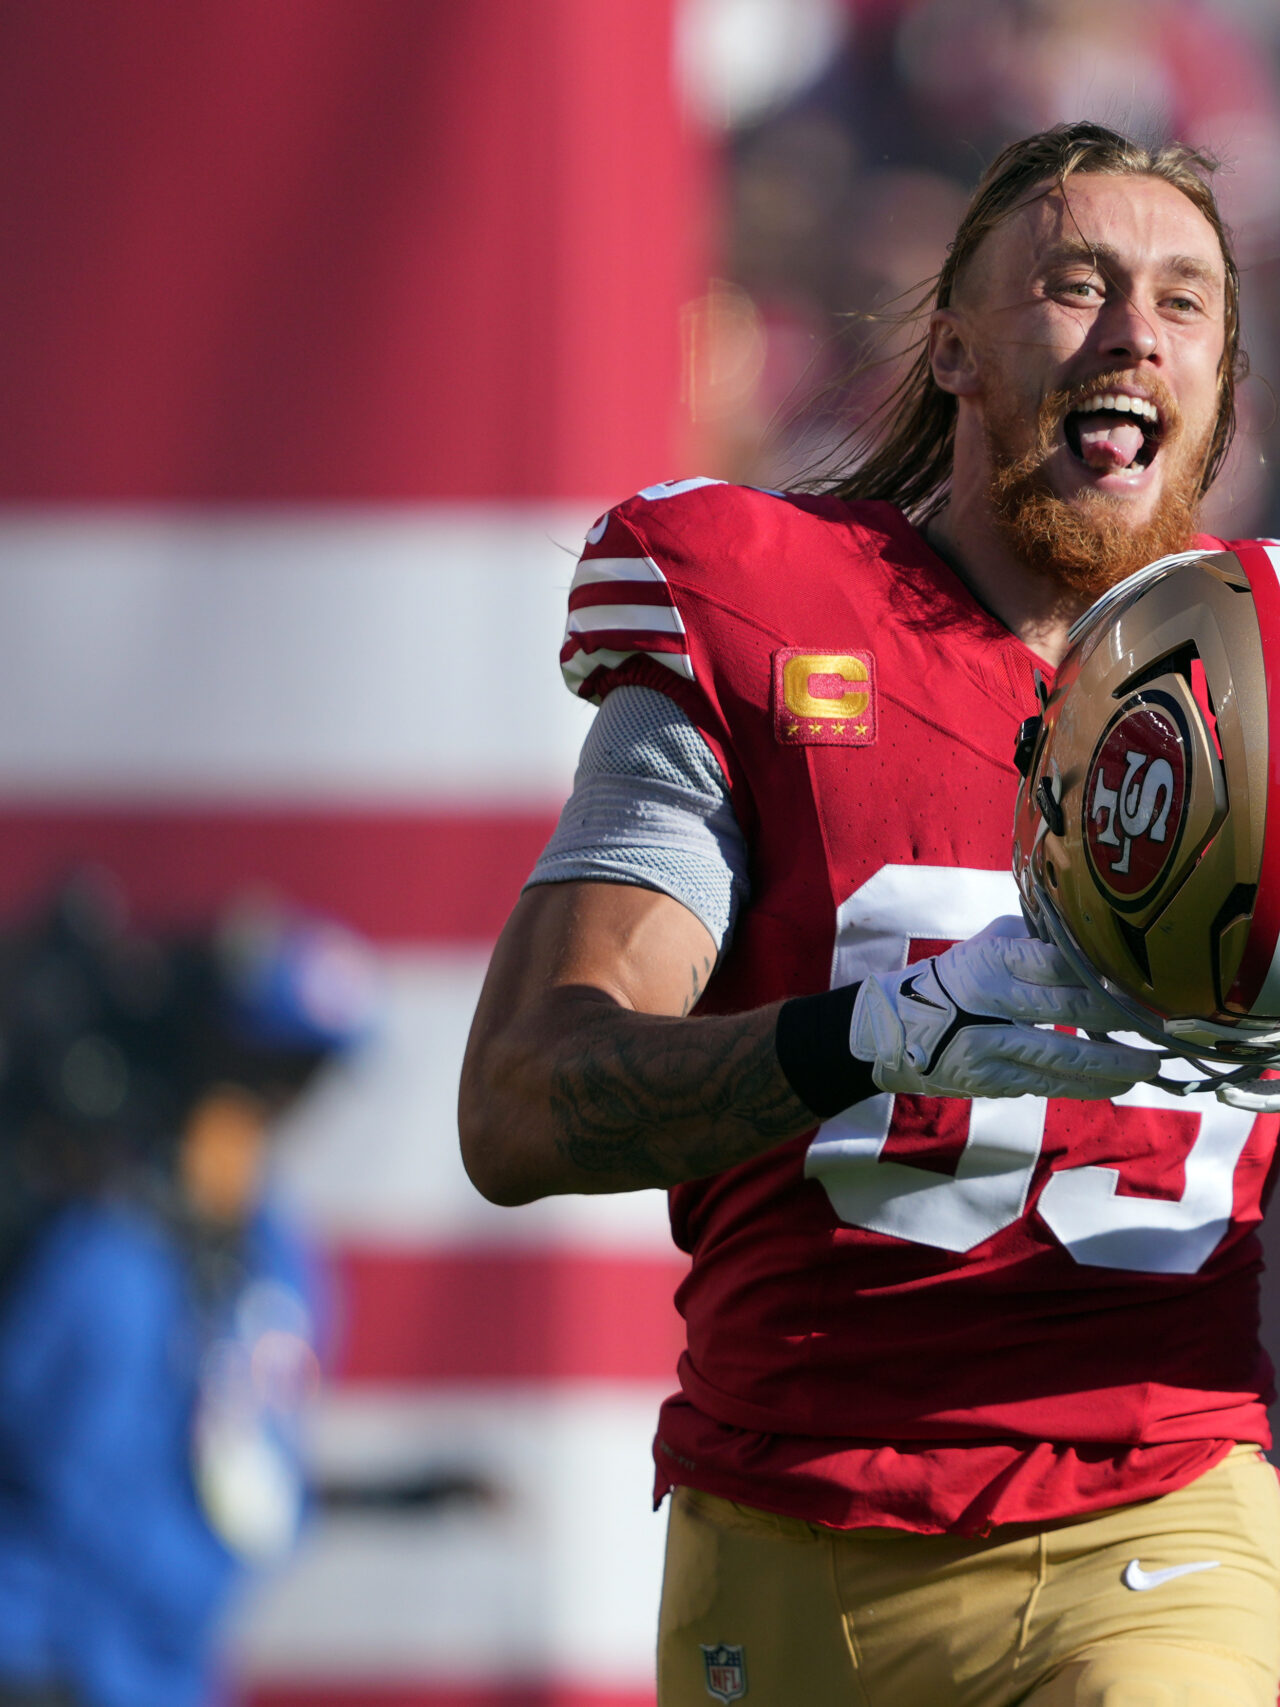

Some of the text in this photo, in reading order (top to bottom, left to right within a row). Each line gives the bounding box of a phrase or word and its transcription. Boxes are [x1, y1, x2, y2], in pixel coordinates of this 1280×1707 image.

[784, 655, 869, 718] C
[1090, 750, 1175, 874] SF
[711, 1668, 742, 1692] NFL
